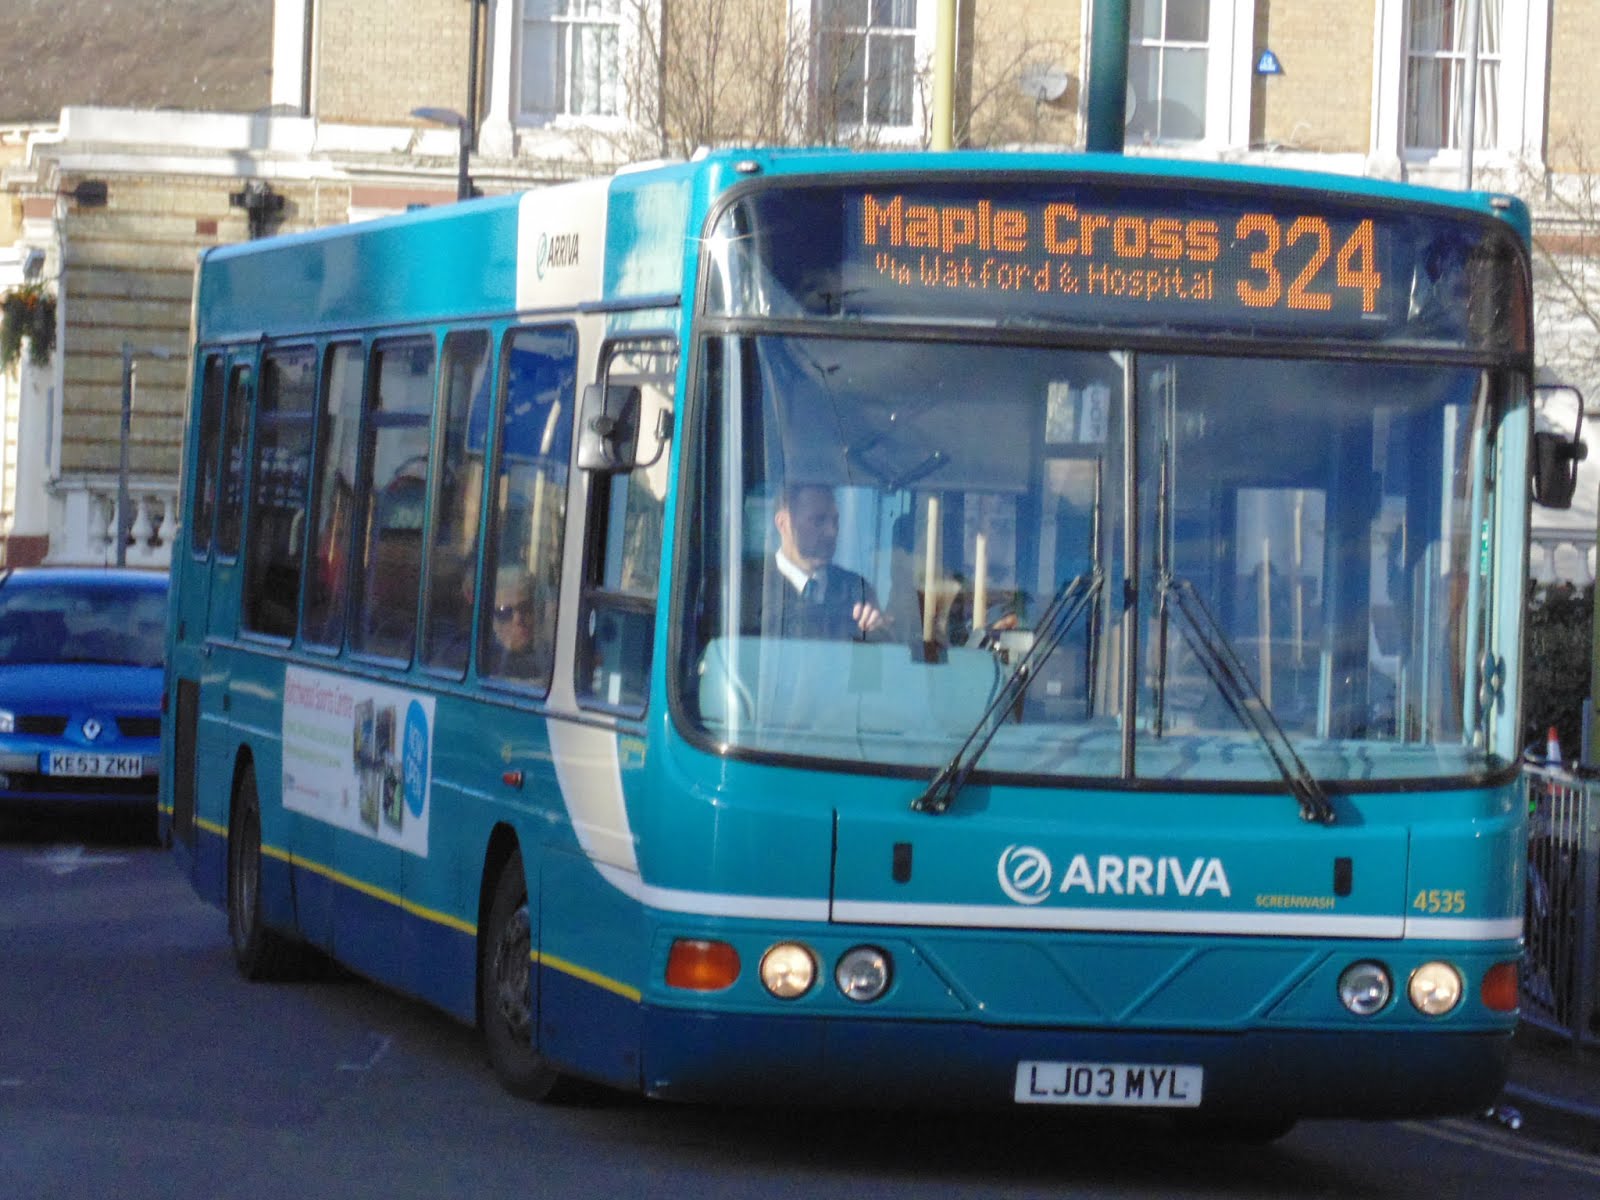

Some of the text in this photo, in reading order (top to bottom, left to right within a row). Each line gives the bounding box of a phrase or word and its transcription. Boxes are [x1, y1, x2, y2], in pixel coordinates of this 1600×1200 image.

[863, 195, 1219, 262] Maple Cross
[547, 232, 579, 267] ARRIVA
[1236, 213, 1382, 312] 324
[920, 255, 1051, 292] Watford
[1060, 261, 1078, 294] &
[1087, 263, 1214, 301] Hospital
[105, 757, 140, 775] ZKH
[1060, 854, 1231, 898] ARRIVA
[1255, 894, 1335, 910] SCREENWASH
[1413, 889, 1466, 913] 4535
[1029, 1066, 1189, 1100] LJ03 MYL
